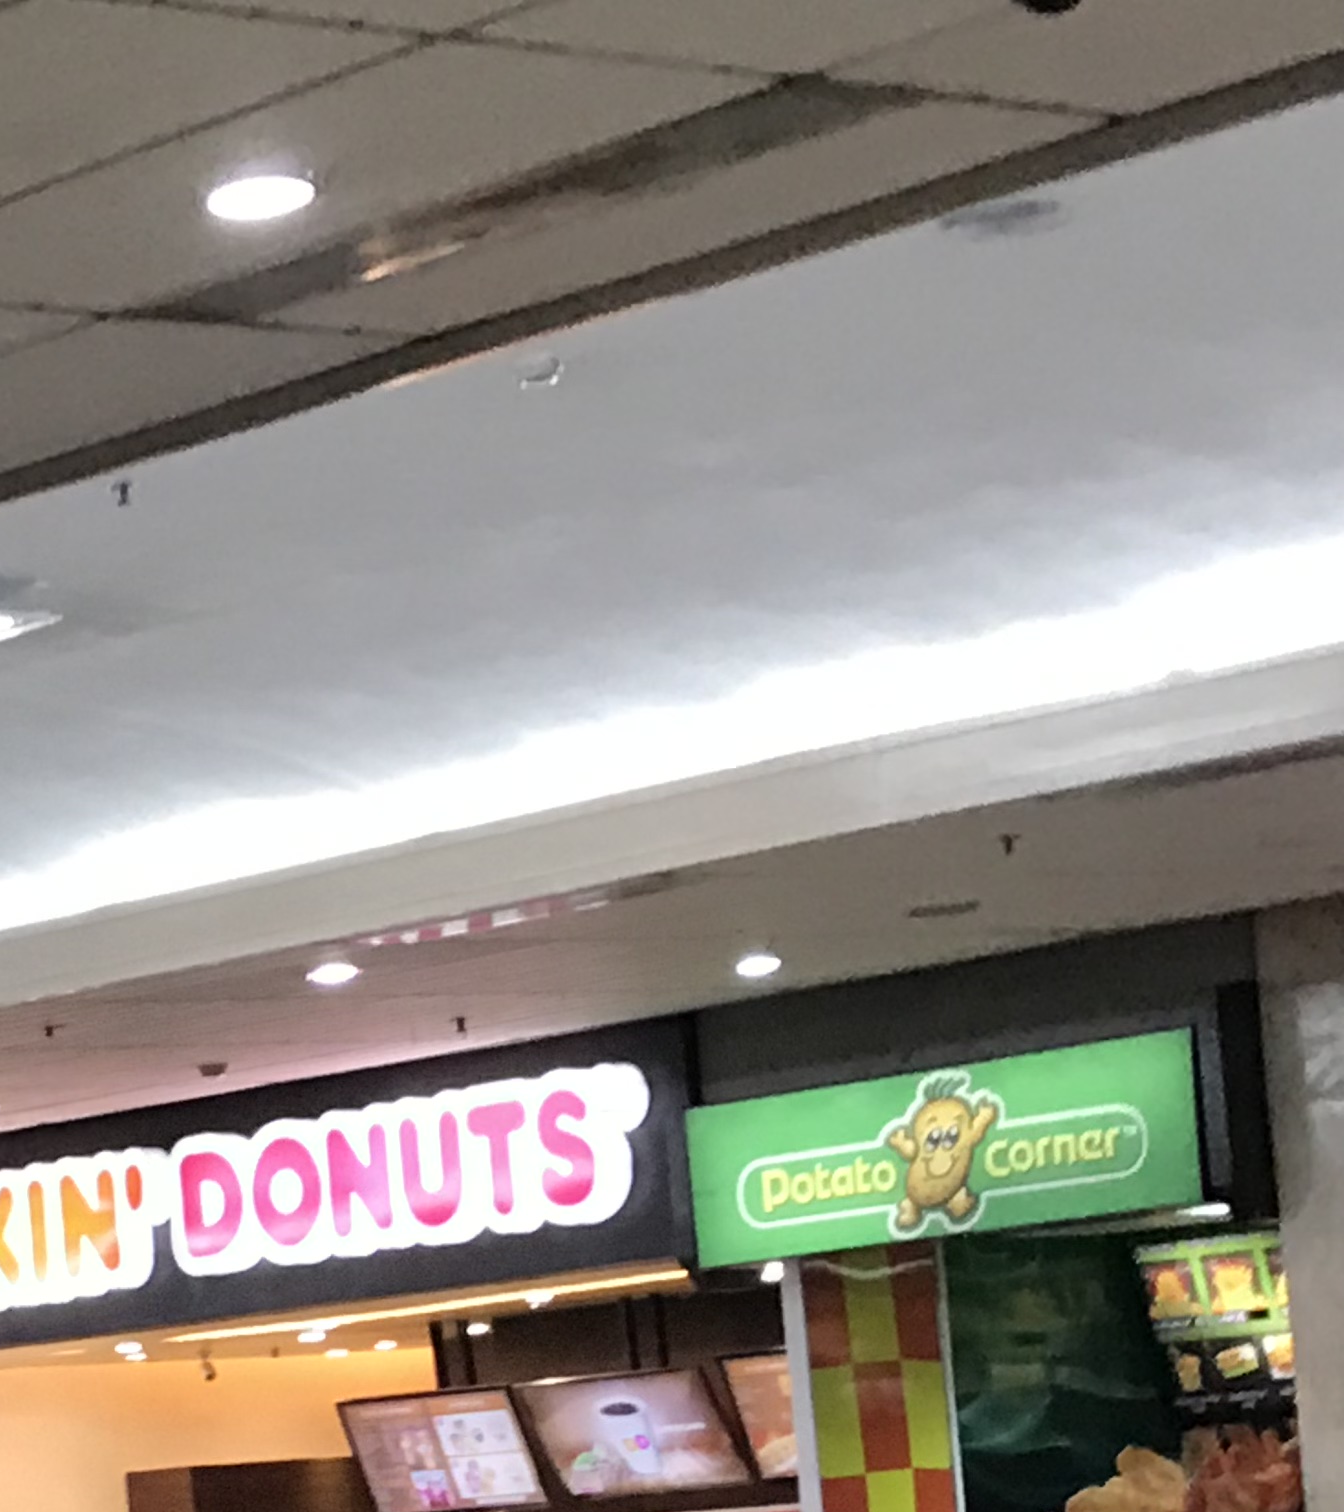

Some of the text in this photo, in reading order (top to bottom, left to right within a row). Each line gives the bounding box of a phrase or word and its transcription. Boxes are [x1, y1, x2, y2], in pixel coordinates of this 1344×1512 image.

[178, 1088, 596, 1258] DONUTS
[760, 1123, 1122, 1213] Potato Corner
